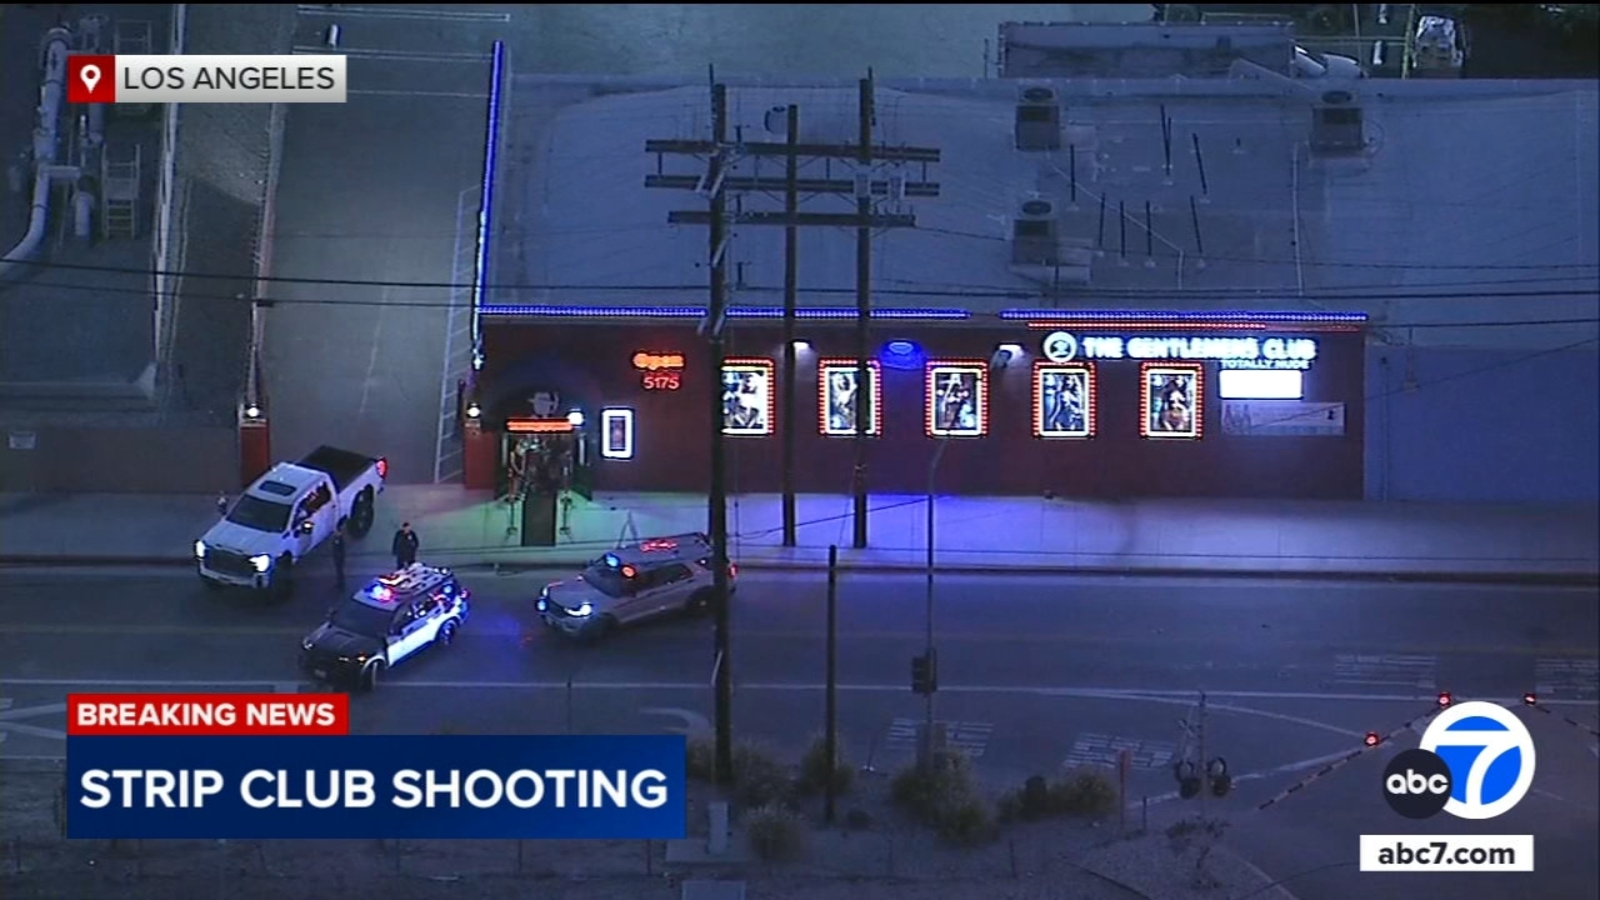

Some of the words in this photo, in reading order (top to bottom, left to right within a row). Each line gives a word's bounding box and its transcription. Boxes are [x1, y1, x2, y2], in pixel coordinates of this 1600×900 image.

[1082, 337, 1123, 359] THE
[1262, 338, 1316, 361] CLUB
[1220, 359, 1275, 369] TOTALLY
[643, 376, 680, 390] 5175
